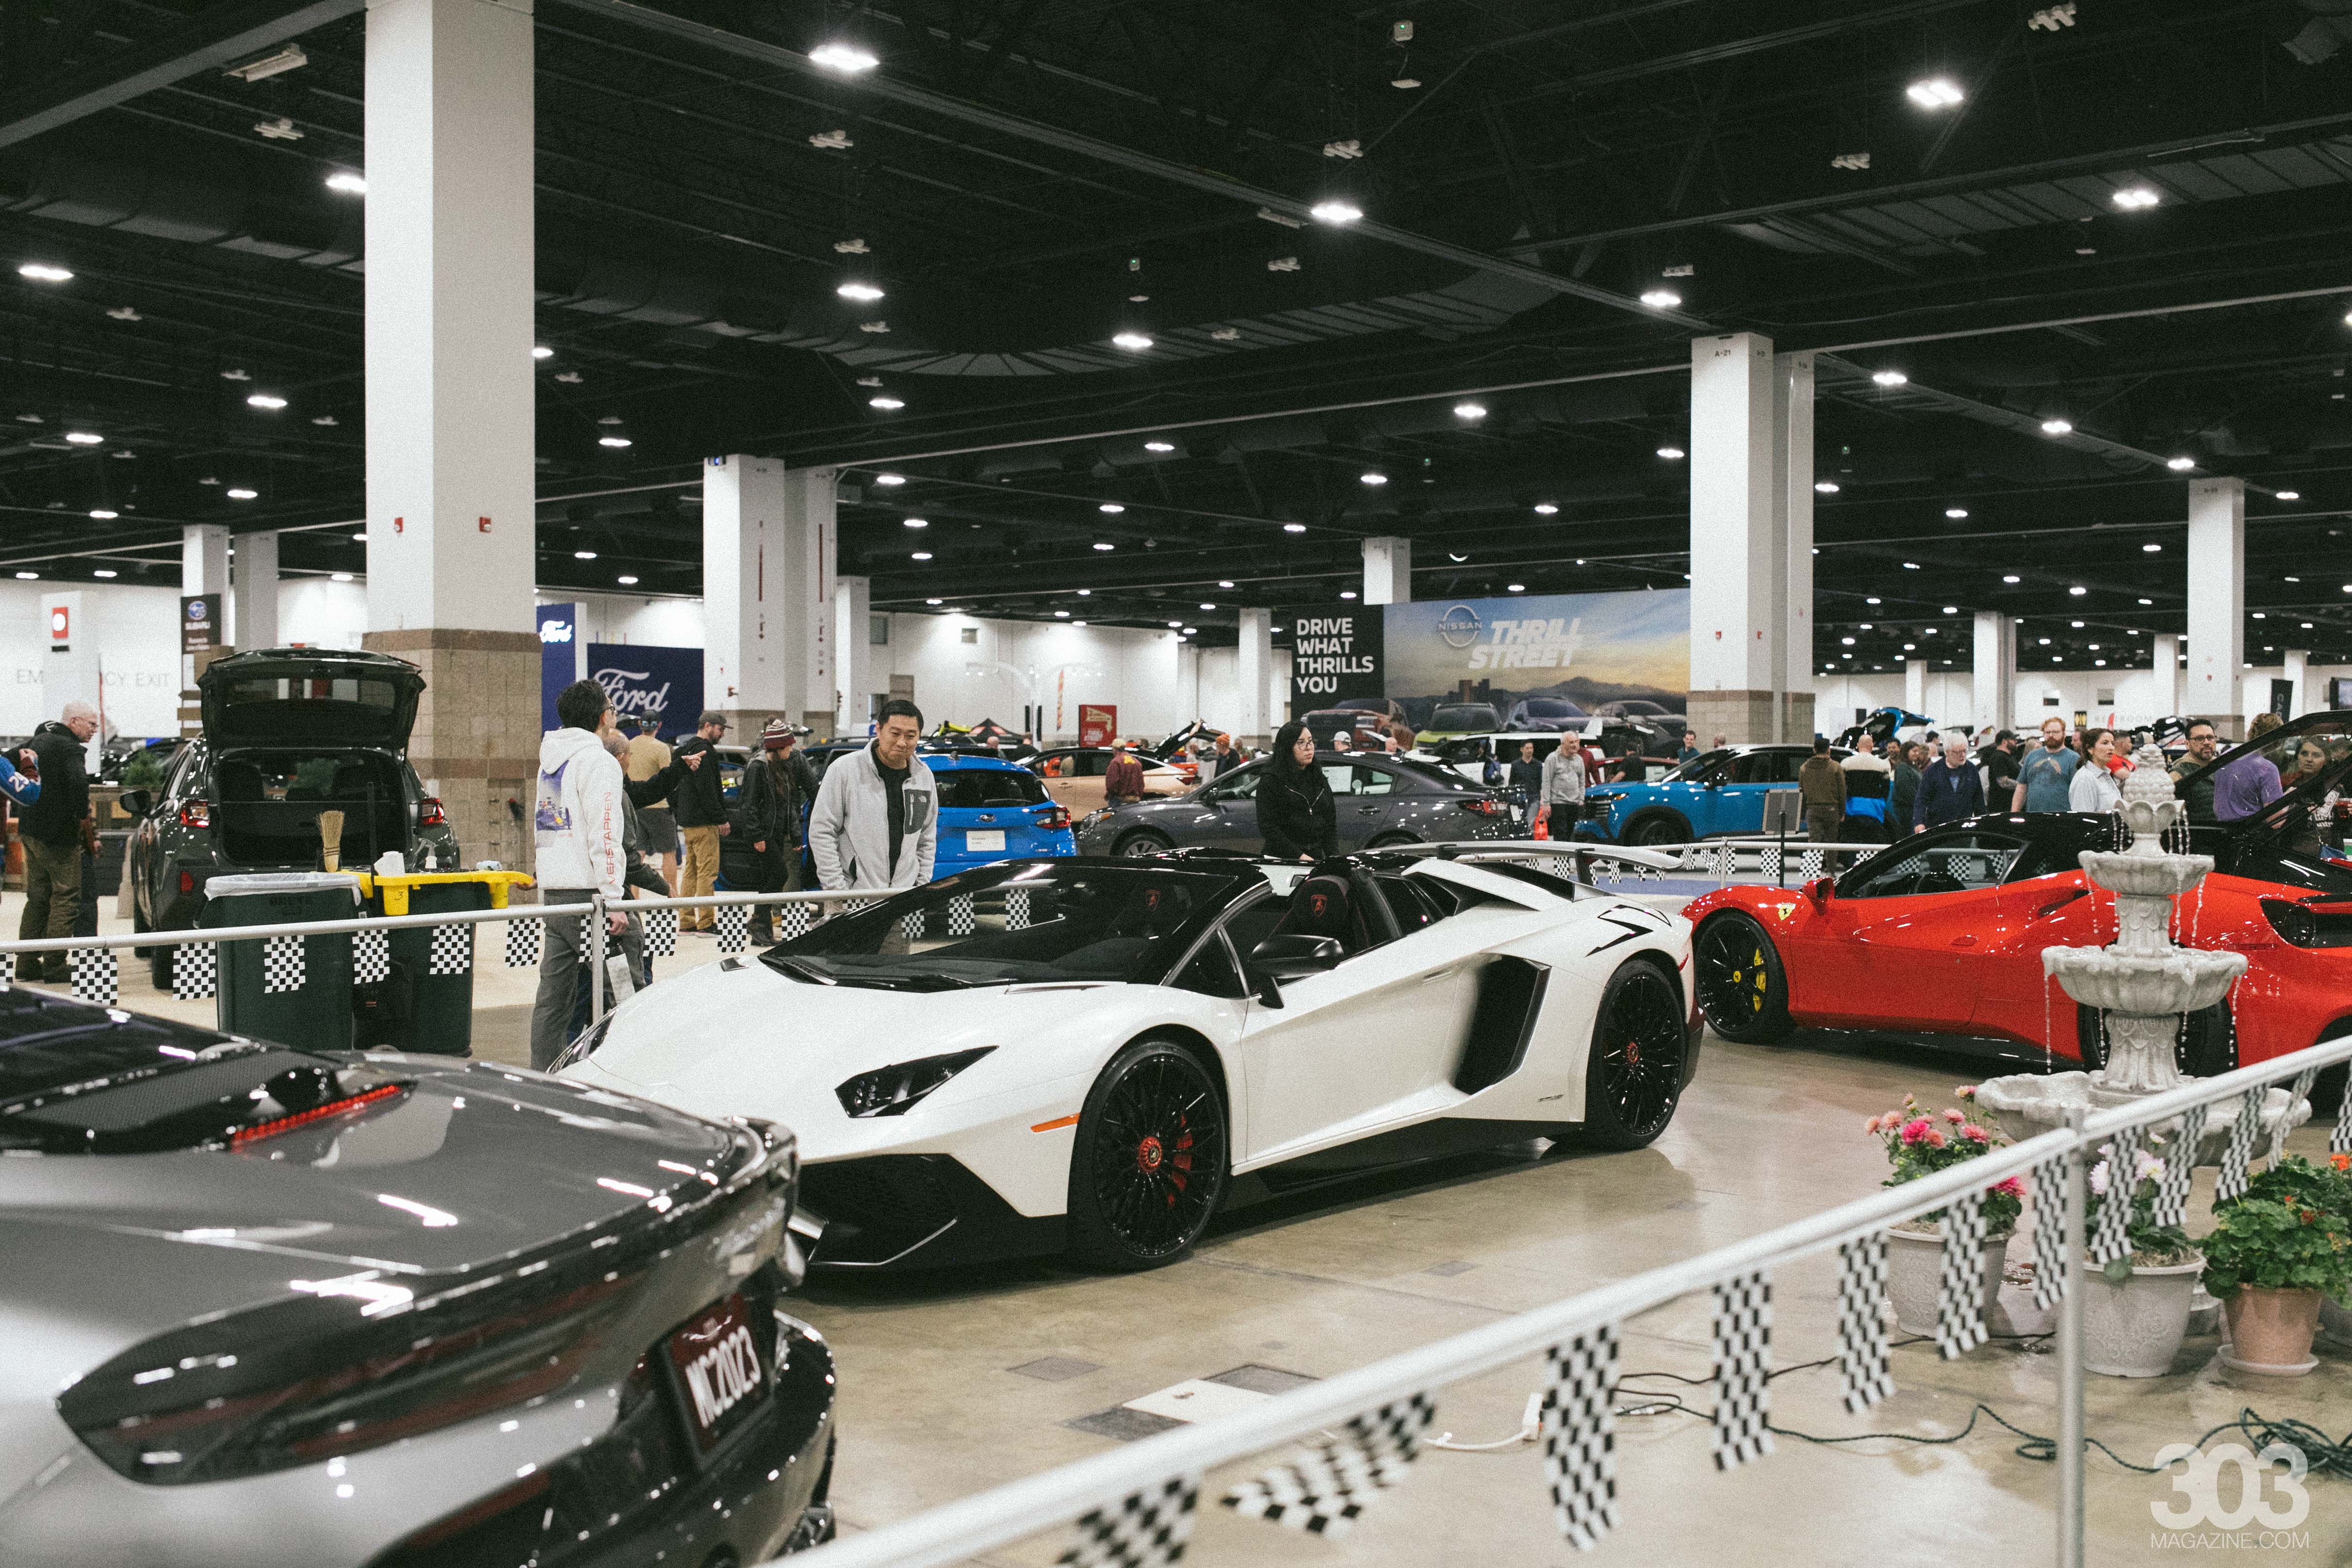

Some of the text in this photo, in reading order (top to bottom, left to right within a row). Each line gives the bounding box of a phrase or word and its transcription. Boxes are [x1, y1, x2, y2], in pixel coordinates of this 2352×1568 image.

[1715, 349, 1731, 358] A-21
[1297, 618, 1353, 636] DRIVE
[1438, 621, 1483, 631] NISSAN
[1491, 618, 1583, 644] THRILL
[1296, 637, 1354, 655] WHAT
[1297, 655, 1374, 674] THRILLS
[1468, 644, 1577, 669] STREET
[593, 668, 670, 712] Ford
[1296, 676, 1338, 694] YOU
[604, 791, 616, 884] VERSTAPPEN
